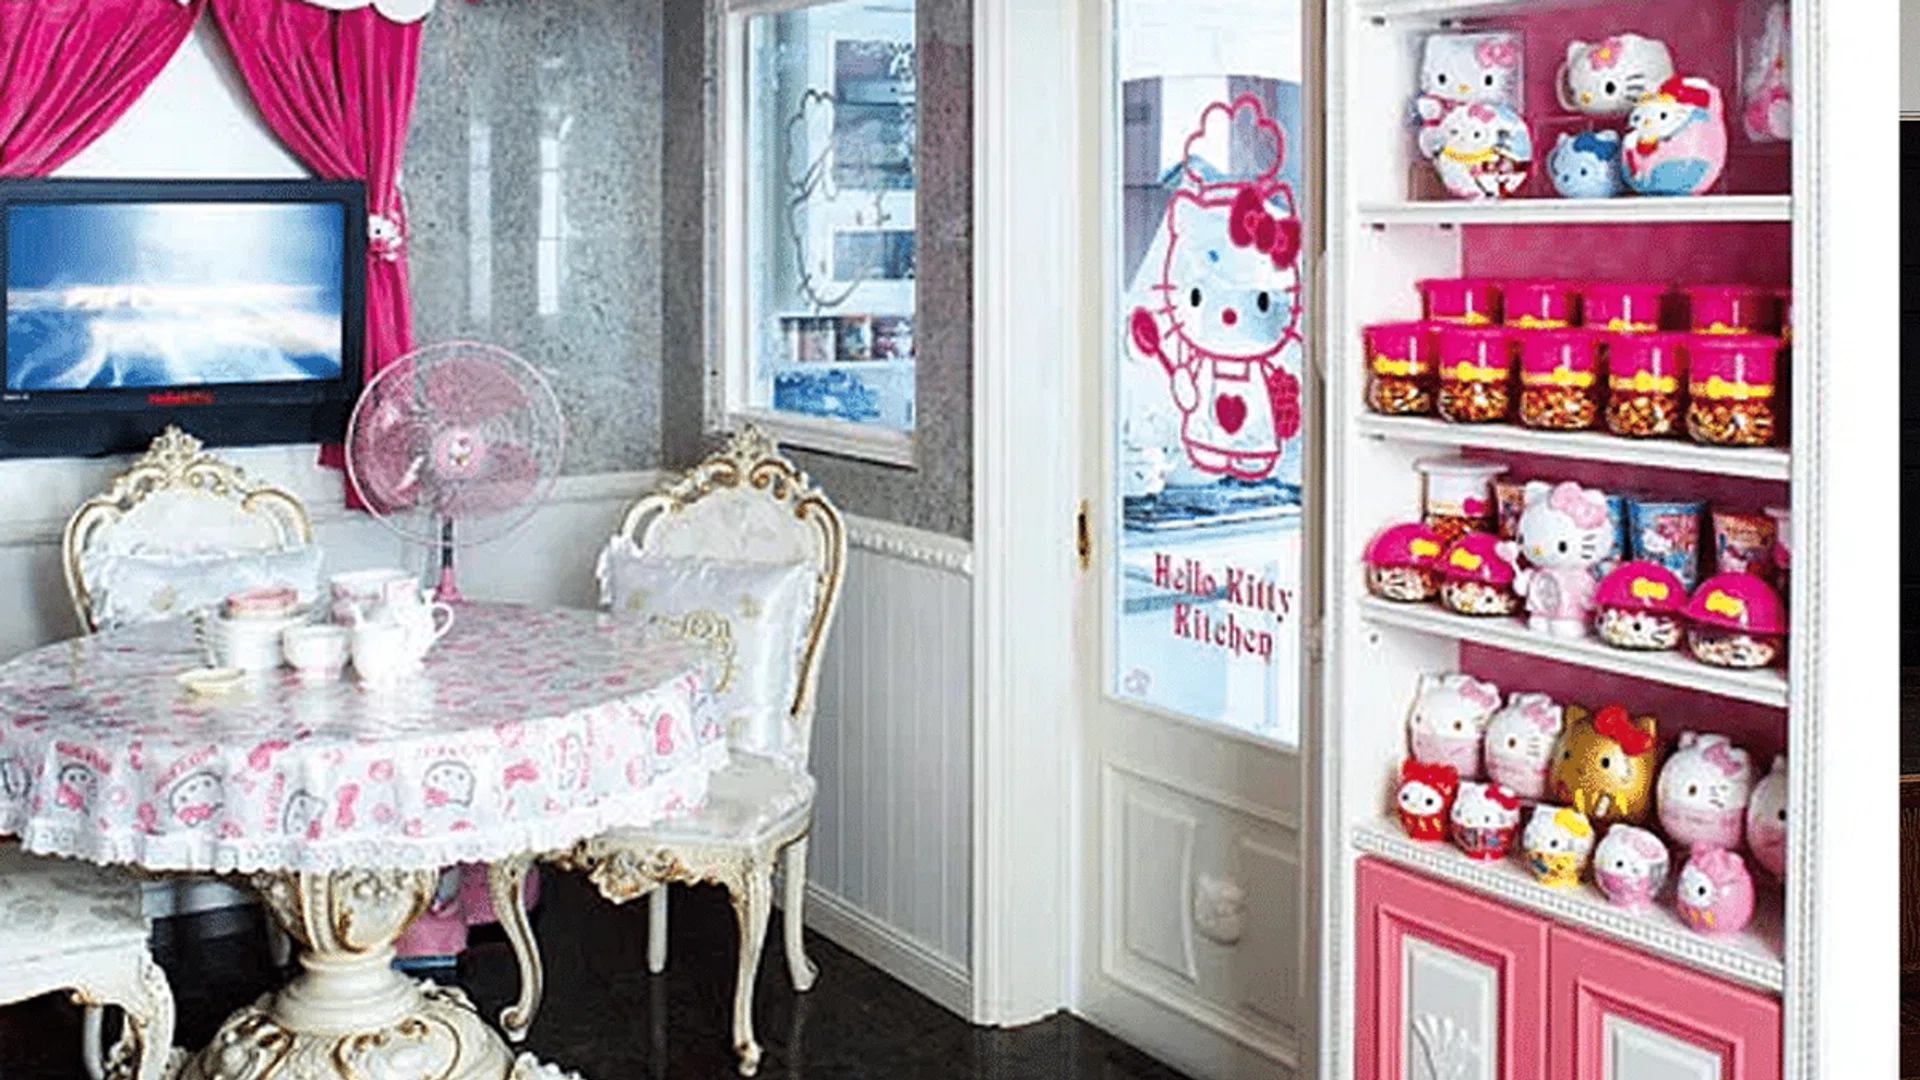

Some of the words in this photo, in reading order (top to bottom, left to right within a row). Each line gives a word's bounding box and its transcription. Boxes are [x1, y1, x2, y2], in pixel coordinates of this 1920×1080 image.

[1155, 552, 1217, 597] Hello
[1226, 566, 1292, 623] Kitty
[1174, 602, 1273, 665] Kitchen
